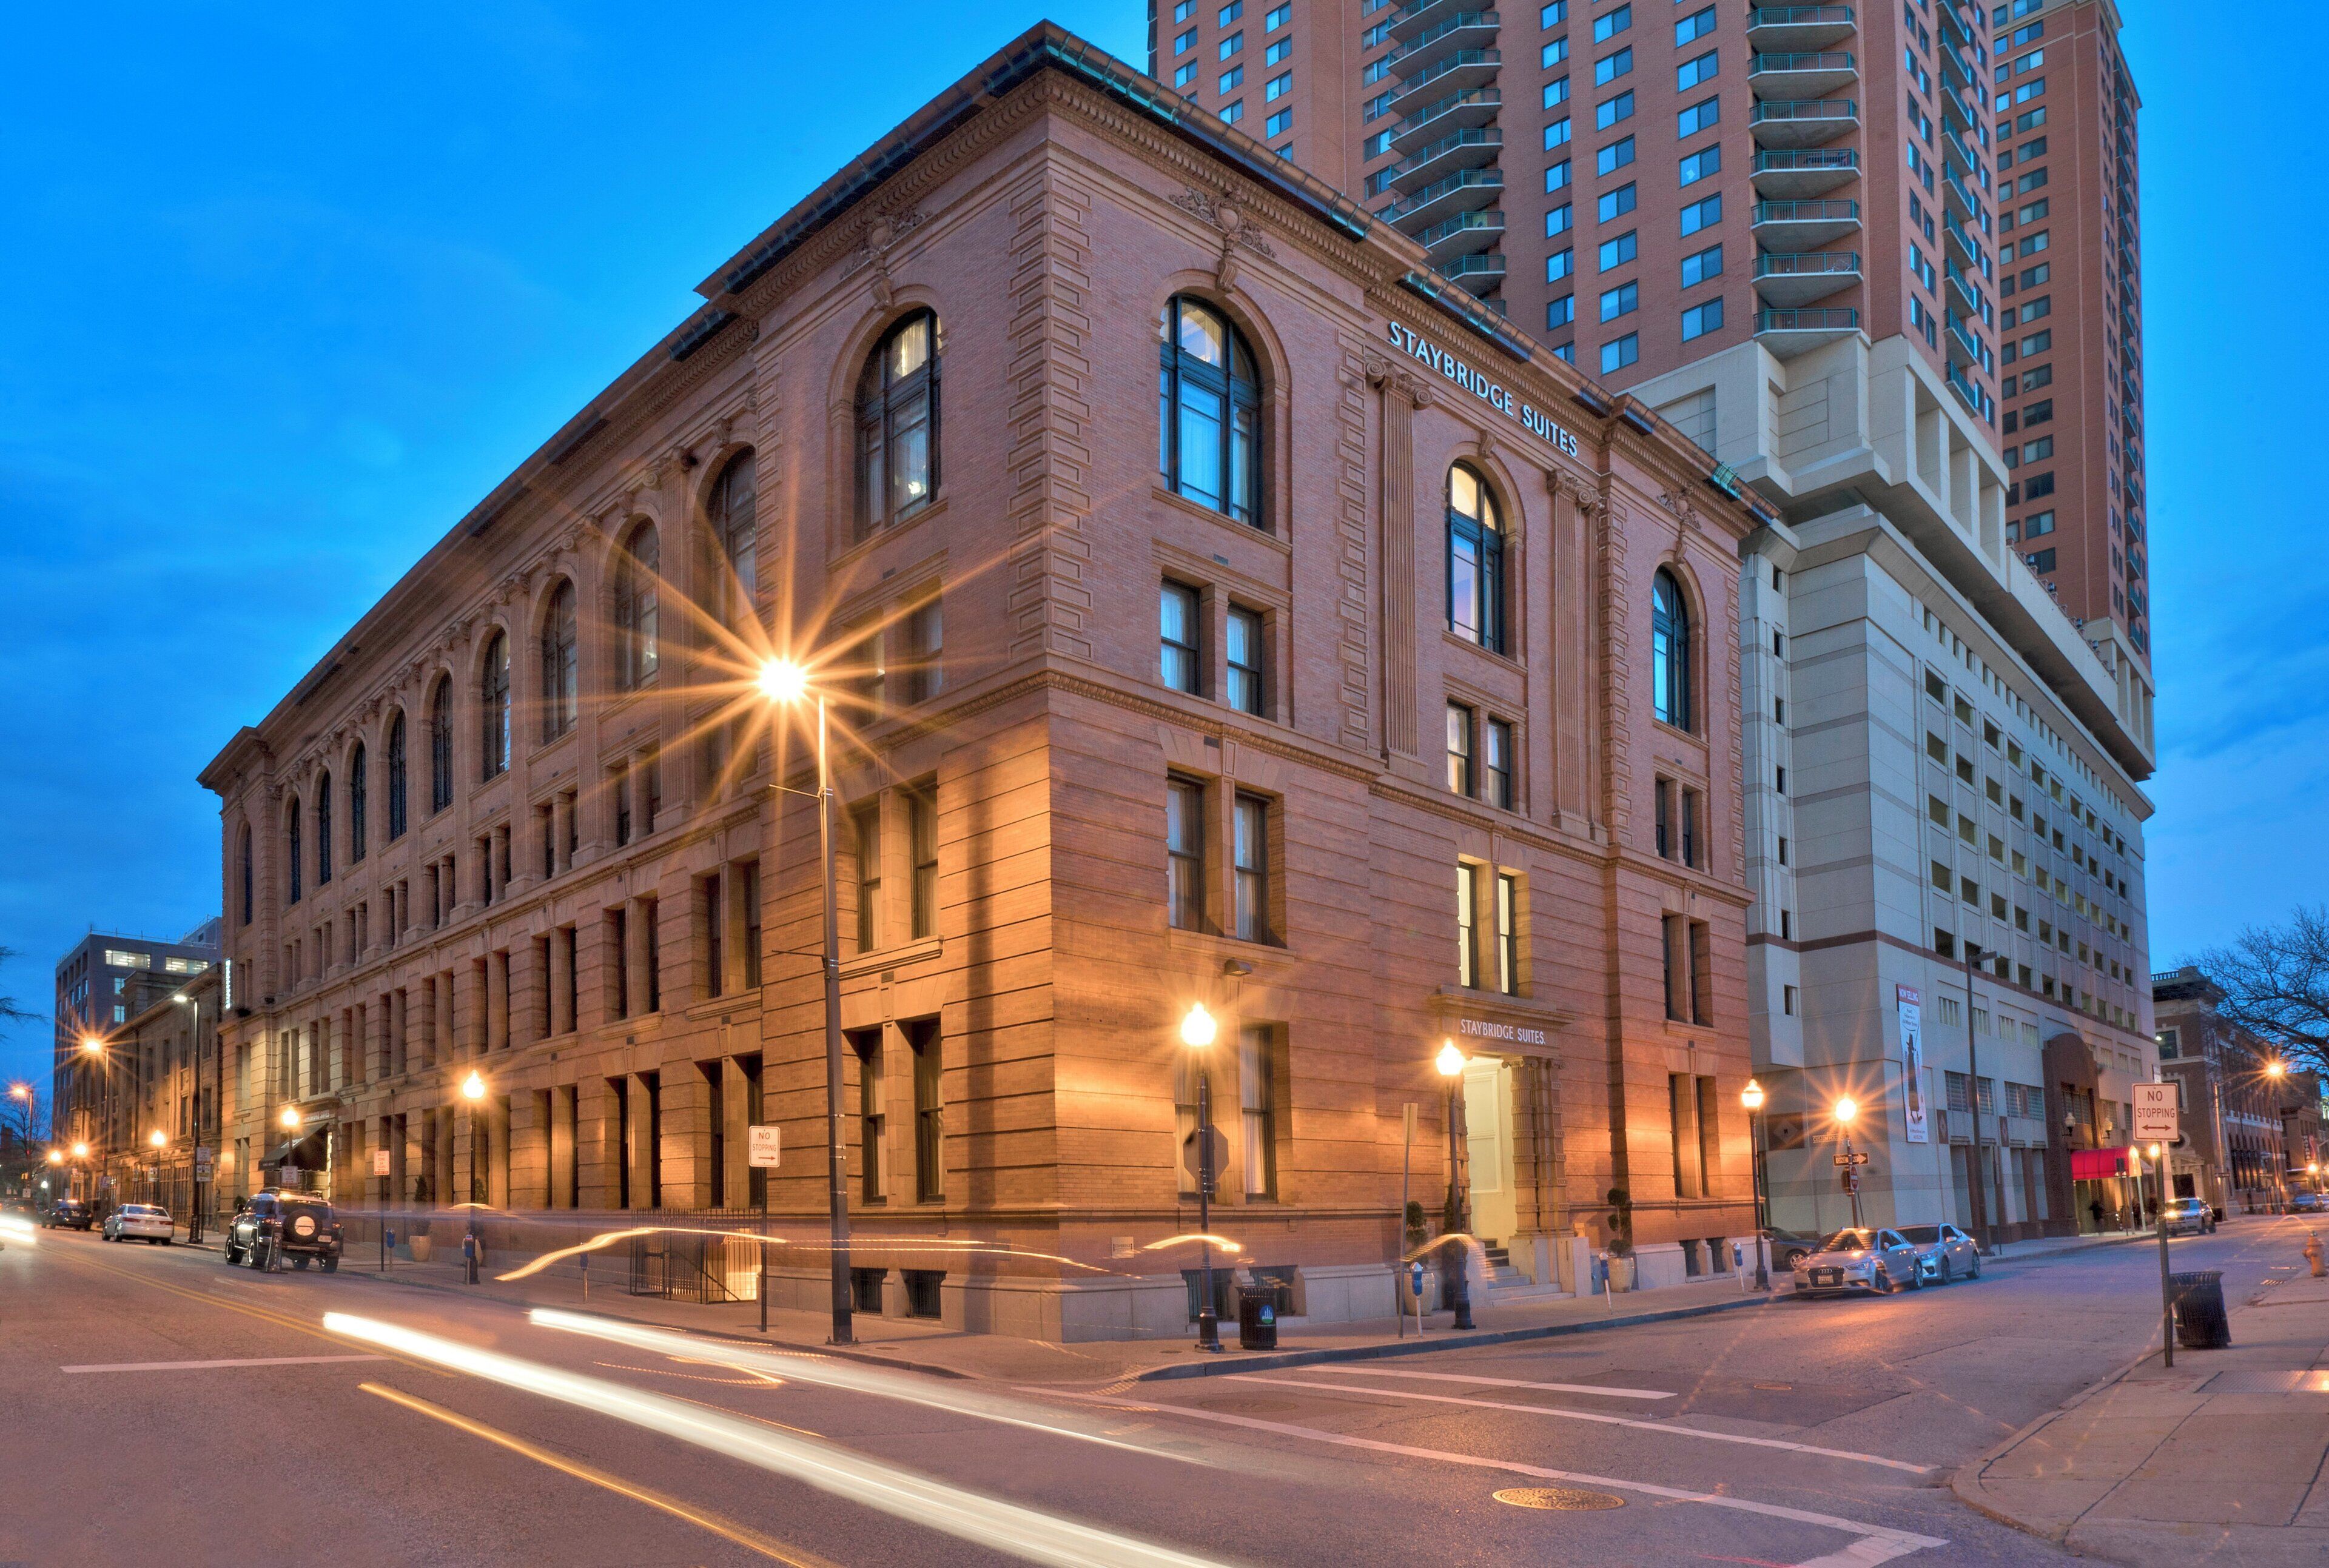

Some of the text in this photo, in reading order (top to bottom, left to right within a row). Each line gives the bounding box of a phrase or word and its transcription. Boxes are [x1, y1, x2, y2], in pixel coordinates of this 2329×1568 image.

[1390, 321, 1578, 458] STAYBRIDGE SUITES
[1460, 1019, 1514, 1040] STAYBRIDGE
[2148, 1091, 2163, 1102] NO
[2137, 1108, 2176, 1118] STOPPING
